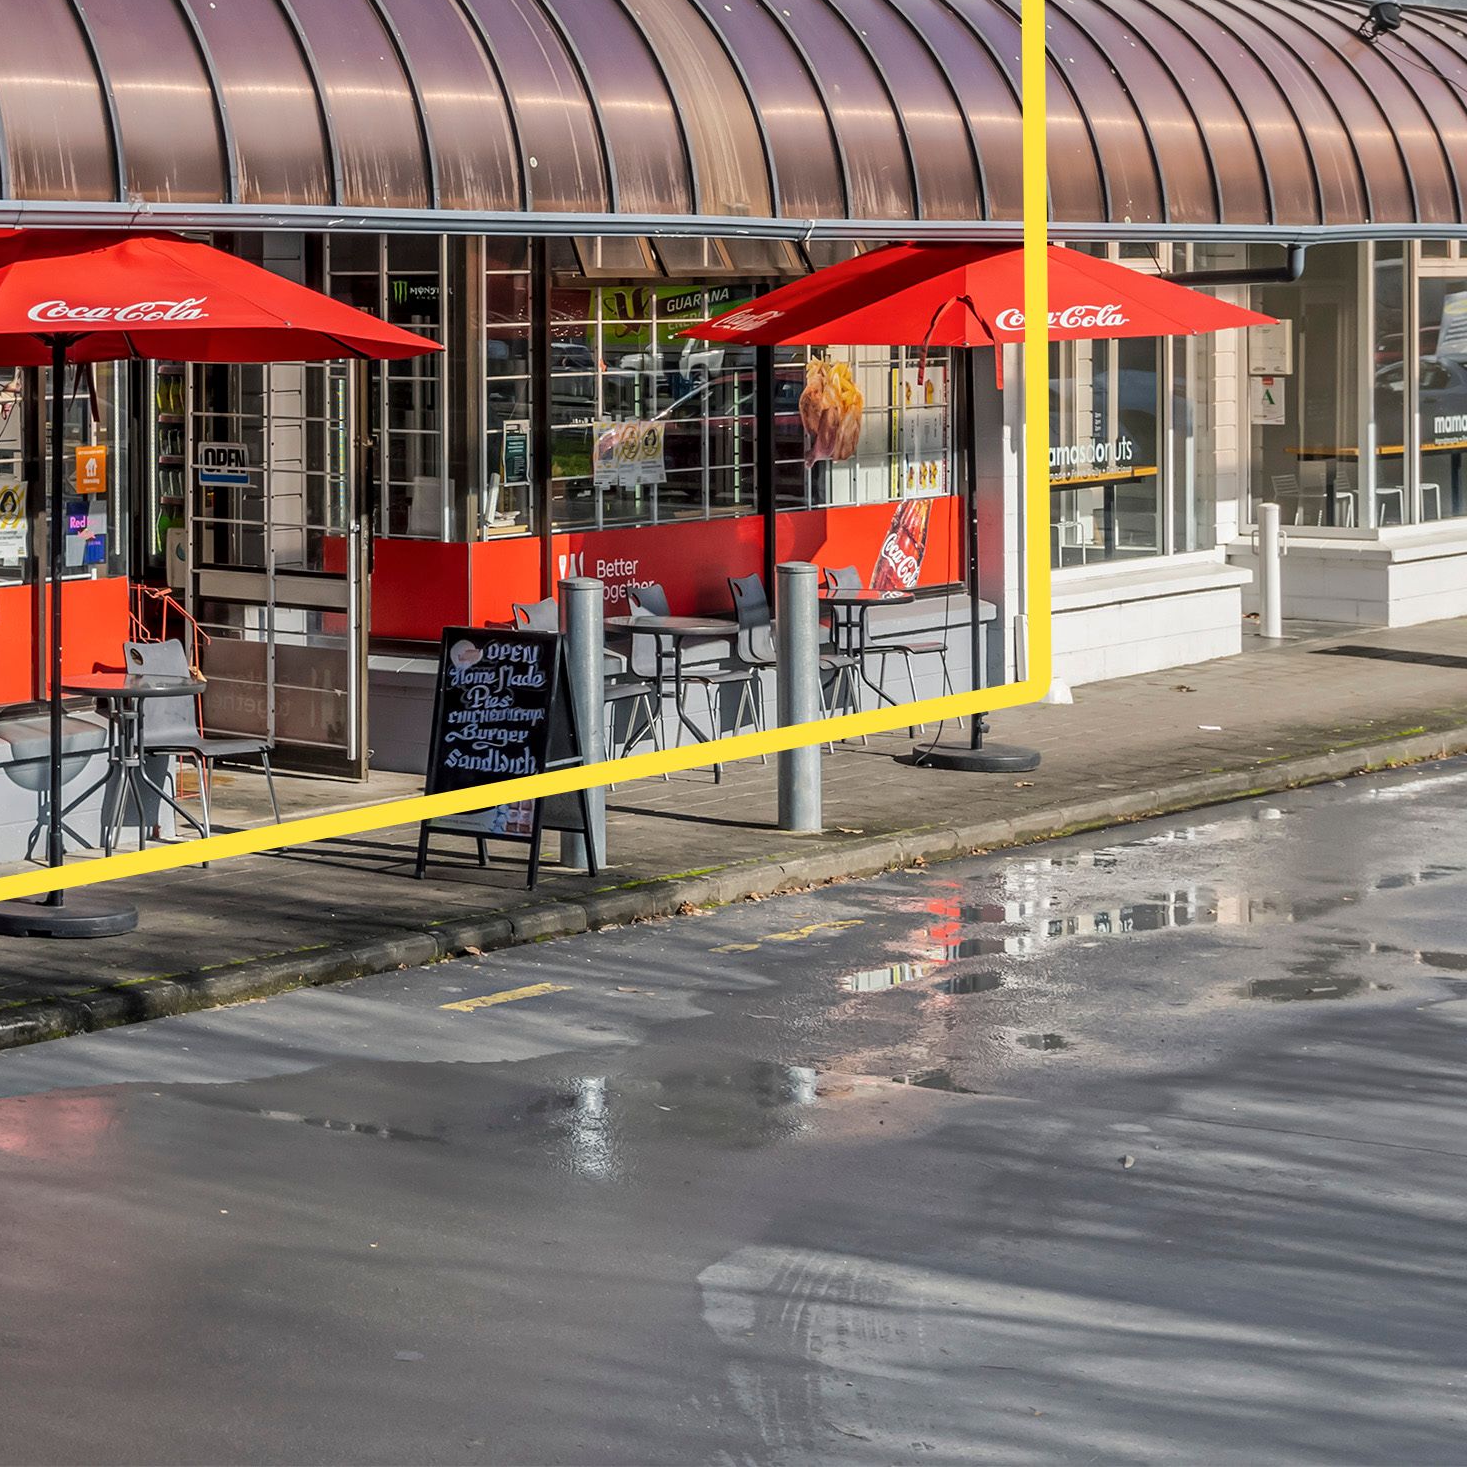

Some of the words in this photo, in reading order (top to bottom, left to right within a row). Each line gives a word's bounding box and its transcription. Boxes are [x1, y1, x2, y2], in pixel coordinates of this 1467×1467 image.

[27, 295, 210, 324] Coca-Cola
[666, 287, 730, 313] GUARNA
[995, 303, 1130, 331] Coa-Cola
[1261, 388, 1276, 405] A
[204, 447, 246, 474] OPEN
[1049, 435, 1133, 467] amasdonuts
[69, 515, 86, 529] Red
[596, 557, 639, 579] Better
[486, 642, 540, 664] OPEN
[449, 666, 499, 687] Home
[467, 684, 514, 709] Pies
[444, 723, 529, 750] Burger
